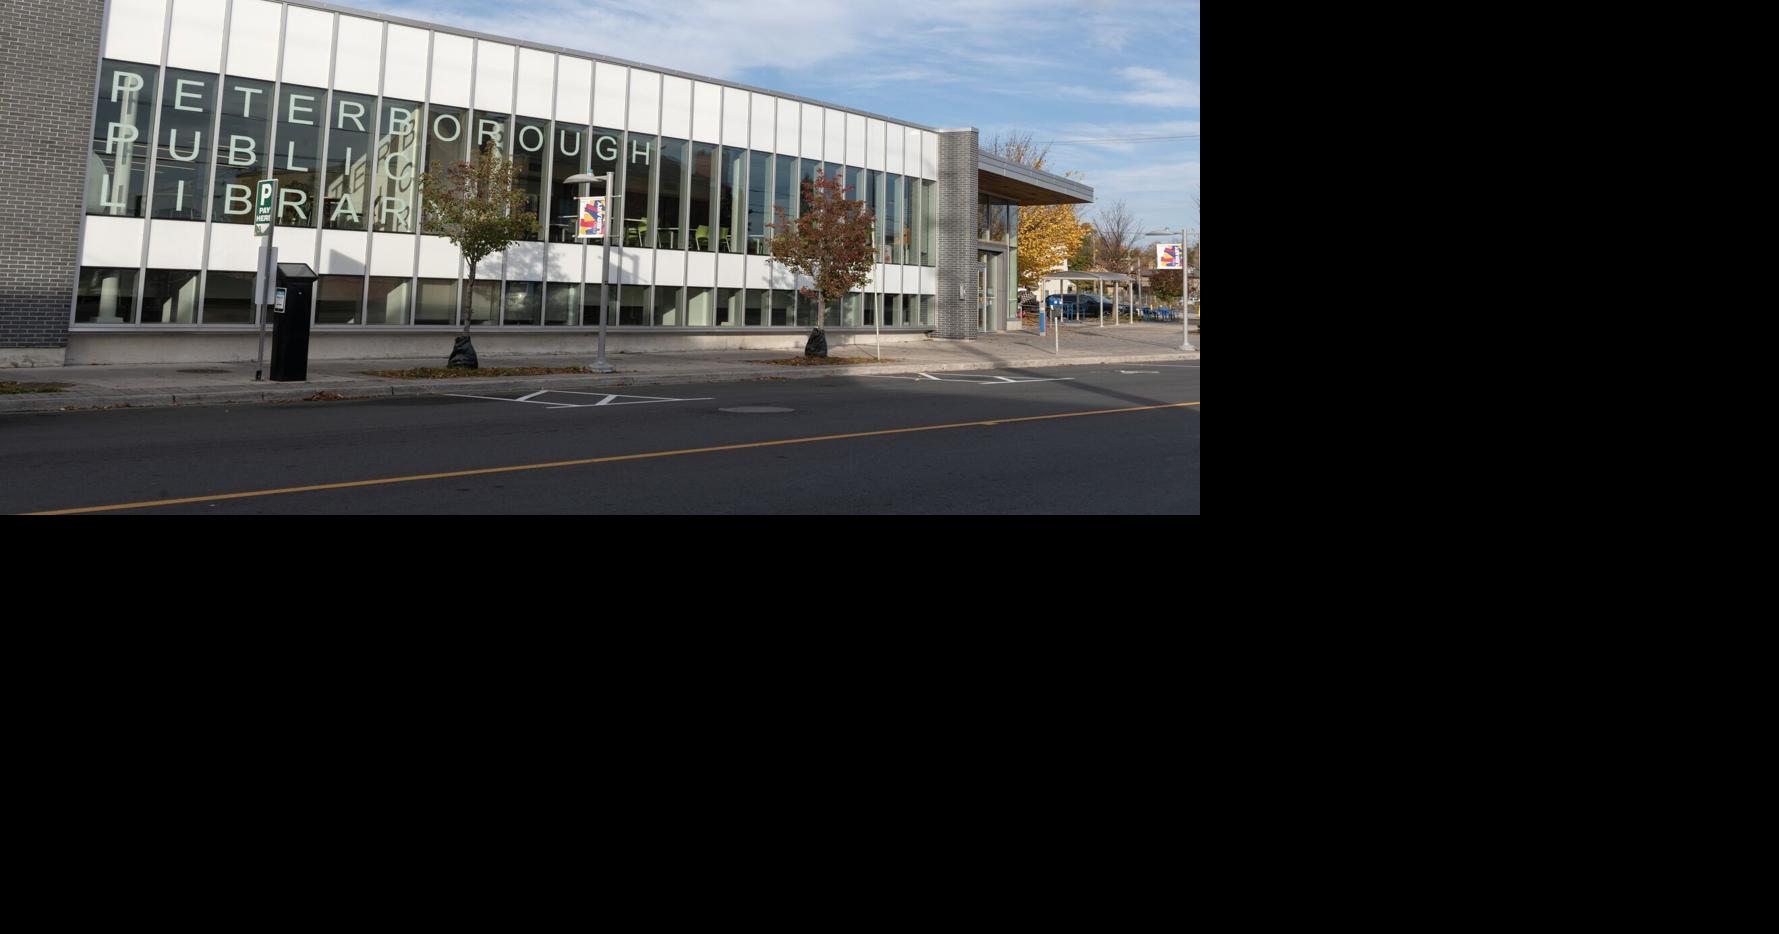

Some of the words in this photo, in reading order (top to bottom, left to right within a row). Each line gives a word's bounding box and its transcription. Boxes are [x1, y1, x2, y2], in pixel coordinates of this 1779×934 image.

[111, 71, 650, 165] PETERBOROUGH
[105, 122, 411, 180] PUBLIC
[260, 183, 272, 206] P
